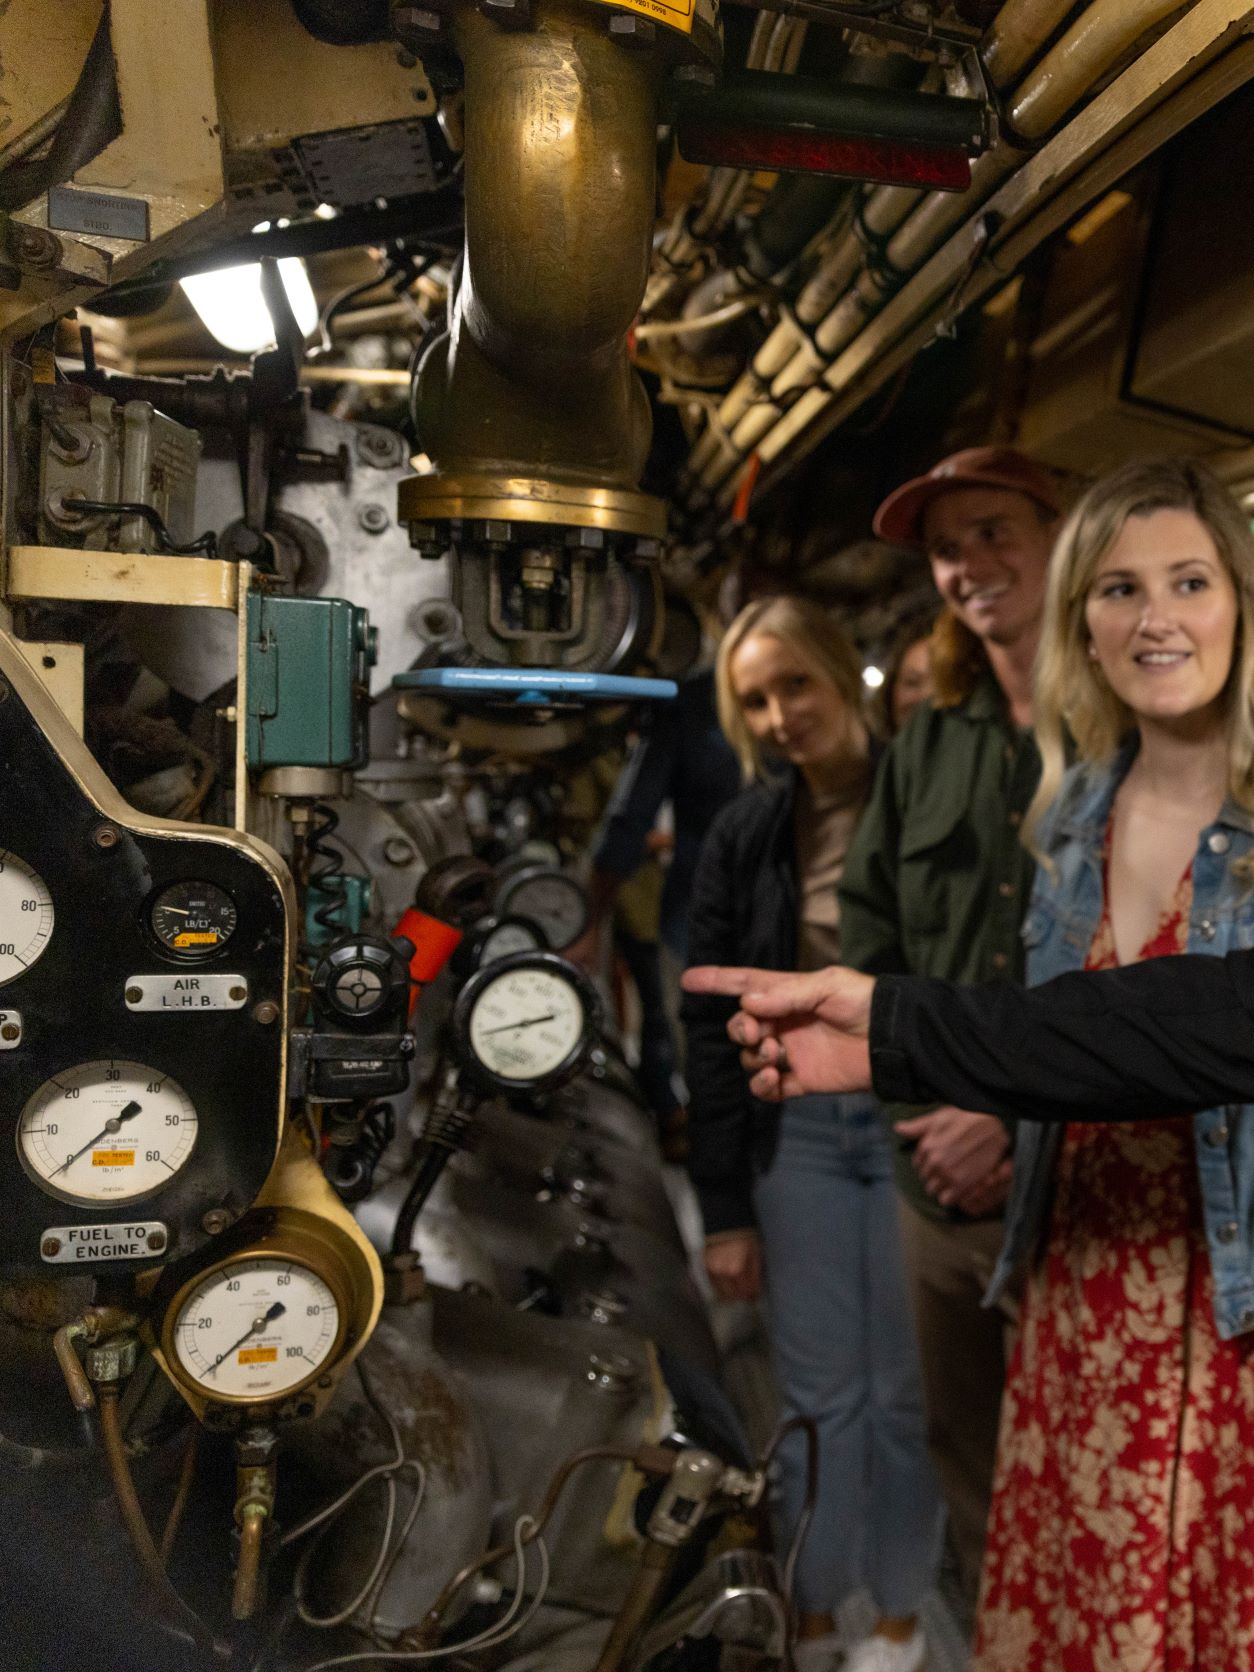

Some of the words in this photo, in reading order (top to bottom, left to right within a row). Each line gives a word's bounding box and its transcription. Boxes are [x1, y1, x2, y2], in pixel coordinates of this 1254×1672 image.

[21, 900, 37, 911] 80
[220, 907, 229, 915] 15
[173, 926, 180, 934] 5
[0, 944, 15, 955] 00
[174, 979, 200, 990] AIR
[162, 996, 217, 1007] L.H.B.
[105, 1069, 120, 1081] 30
[146, 1082, 161, 1094] 40
[64, 1088, 80, 1100] 20
[165, 1115, 180, 1126] 50
[45, 1124, 59, 1135] 10
[66, 1154, 75, 1166] 0
[145, 1151, 161, 1162] 60
[68, 1229, 114, 1242] FUEL
[124, 1227, 146, 1239] TO
[76, 1243, 146, 1259] ENGINE.
[277, 1275, 291, 1286] 60
[226, 1281, 240, 1292] 40
[306, 1305, 320, 1316] 80
[198, 1318, 212, 1329] 20
[286, 1347, 303, 1358] 100
[215, 1354, 224, 1365] 0
